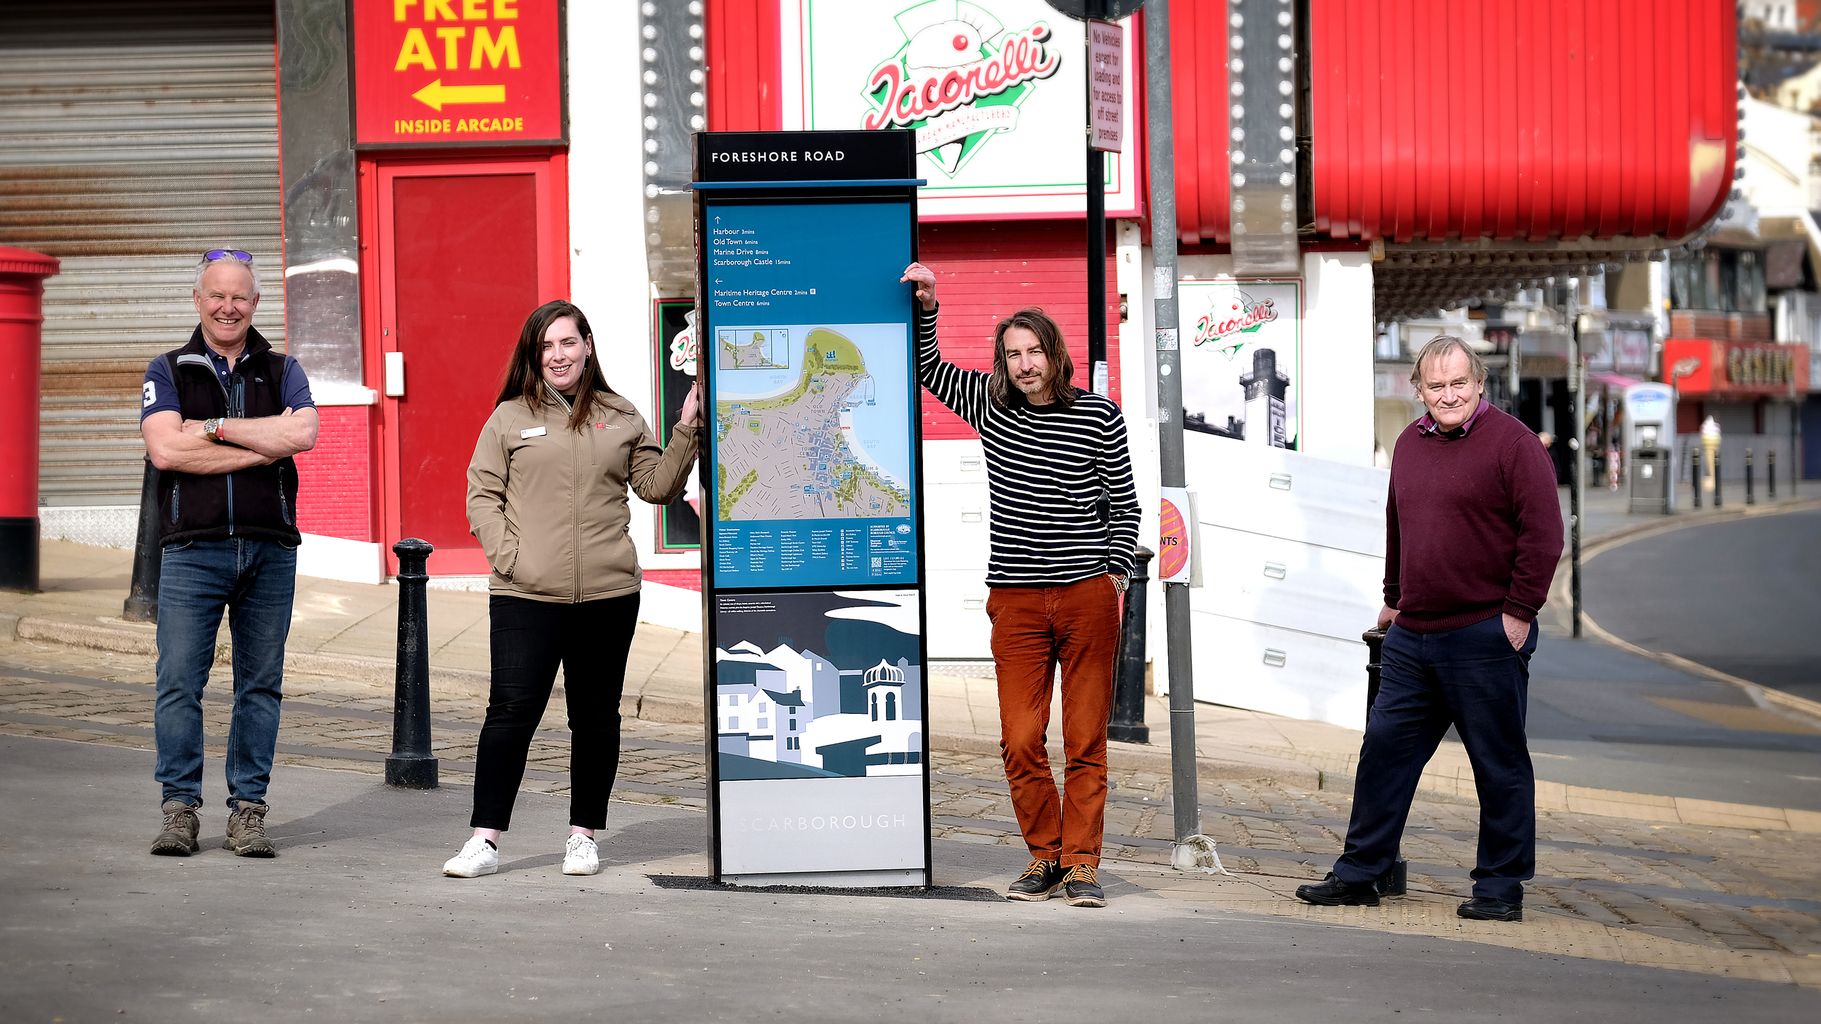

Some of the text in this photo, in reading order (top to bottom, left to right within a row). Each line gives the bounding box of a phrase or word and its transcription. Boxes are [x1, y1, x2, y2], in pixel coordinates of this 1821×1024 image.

[394, 25, 522, 71] ATM
[865, 26, 1056, 130] Jaconelli
[1094, 67, 1111, 87] loading
[394, 117, 524, 133] INSIDE ARCADE
[711, 150, 845, 164] FORESHORE ROAD
[713, 258, 752, 267] Scarborough
[743, 289, 769, 297] Heritage
[770, 288, 793, 296] Centre
[714, 299, 731, 307] Town
[732, 299, 754, 307] Centre
[1194, 298, 1278, 342] Jaconelli
[735, 814, 906, 833] SCARBOROUGH
